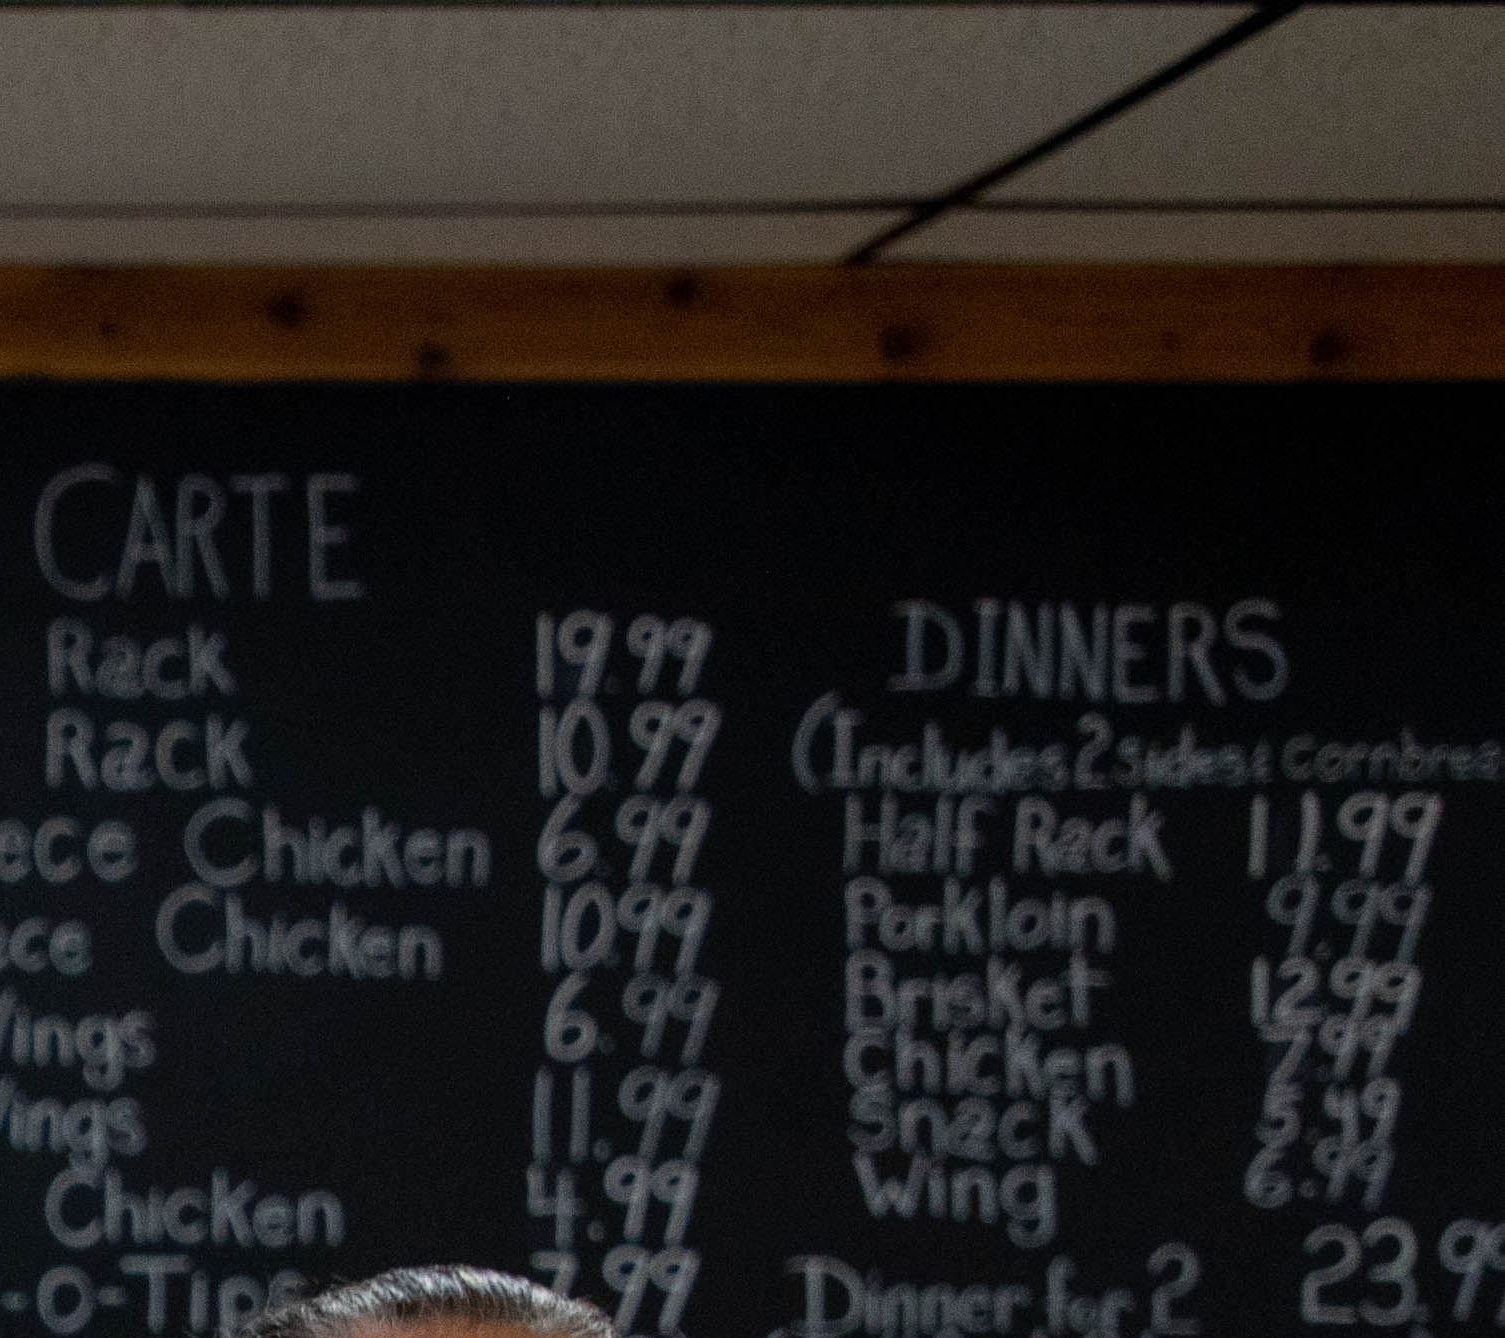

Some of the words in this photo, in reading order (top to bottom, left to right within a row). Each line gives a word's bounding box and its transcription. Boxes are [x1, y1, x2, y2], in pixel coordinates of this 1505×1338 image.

[33, 461, 364, 600] CARTE
[44, 616, 236, 701] Rack
[885, 595, 1292, 706] DINNERS
[42, 706, 253, 794] Rack
[180, 797, 488, 888] Chicken
[842, 791, 996, 877] Half
[1012, 791, 1174, 882] Rack
[153, 882, 444, 983] Chicken
[841, 949, 1116, 1033] Brisket
[840, 1028, 1136, 1110] Chicken
[845, 1082, 1100, 1168] Snack
[45, 1166, 347, 1250] Chicken
[849, 1150, 1059, 1250] Wing
[784, 1251, 1032, 1337] Dinner
[1044, 1252, 1136, 1338] for
[1146, 1240, 1202, 1337] 2
